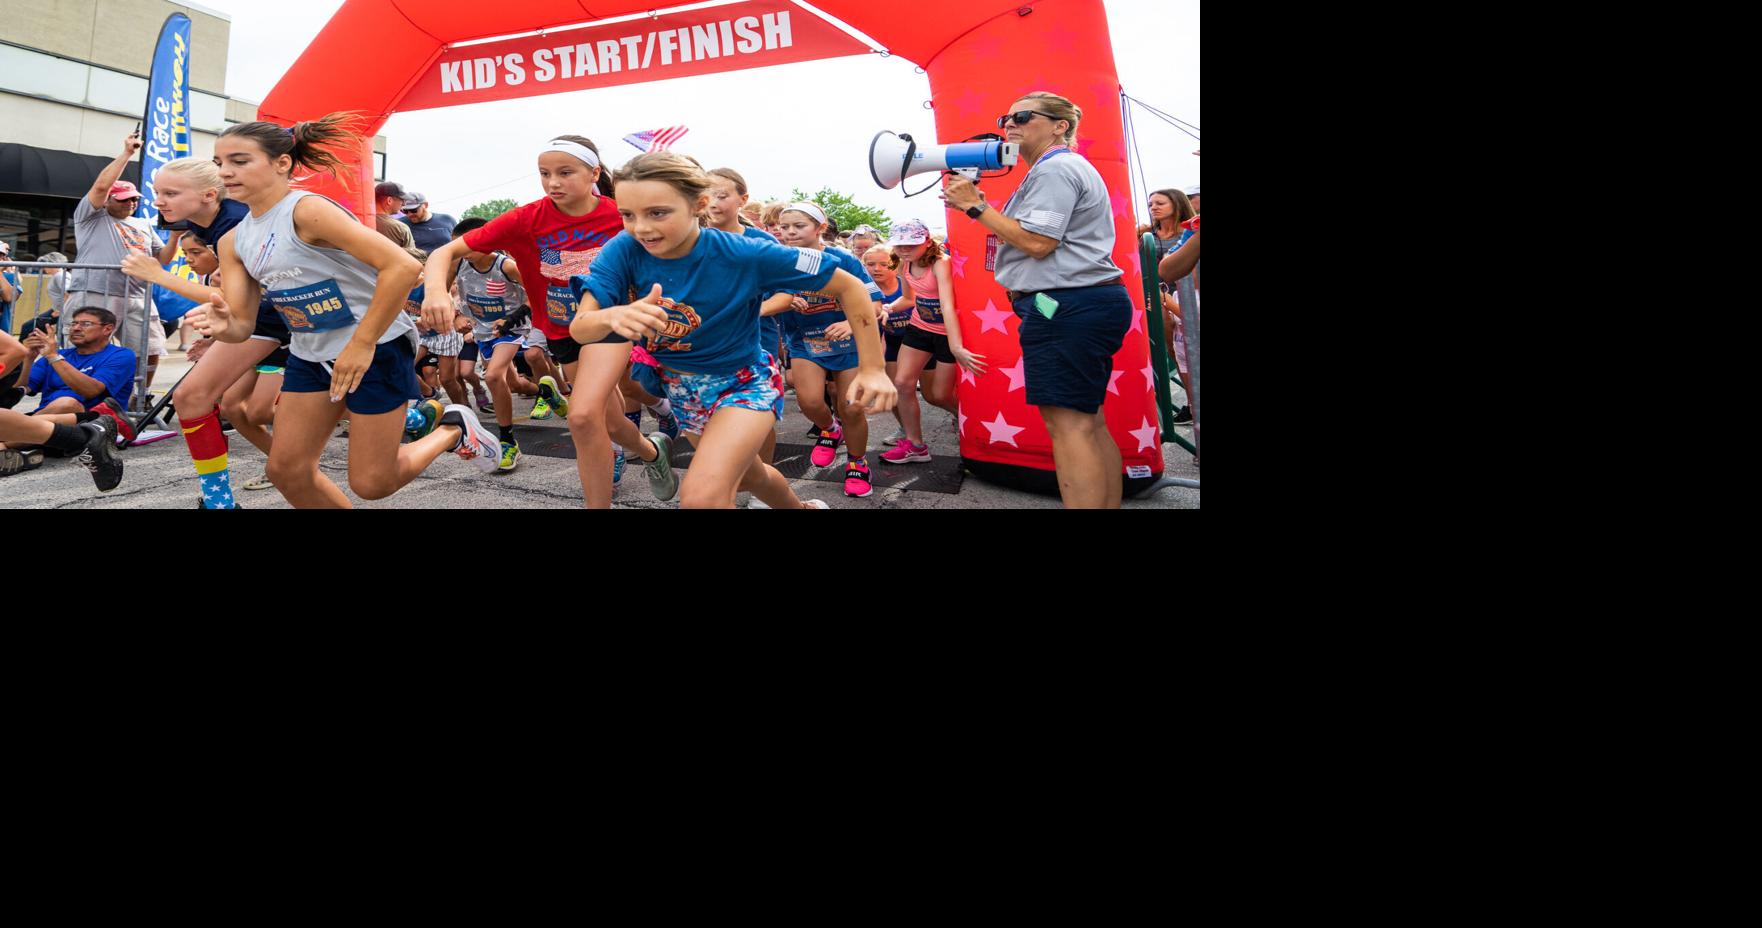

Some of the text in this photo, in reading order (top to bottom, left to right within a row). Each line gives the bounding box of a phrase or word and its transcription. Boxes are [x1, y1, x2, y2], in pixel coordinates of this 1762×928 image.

[440, 10, 793, 94] KID'S START/FINISH
[146, 96, 170, 163] Race
[537, 231, 569, 249] OLD
[315, 287, 331, 297] RUN
[305, 297, 343, 315] 1945
